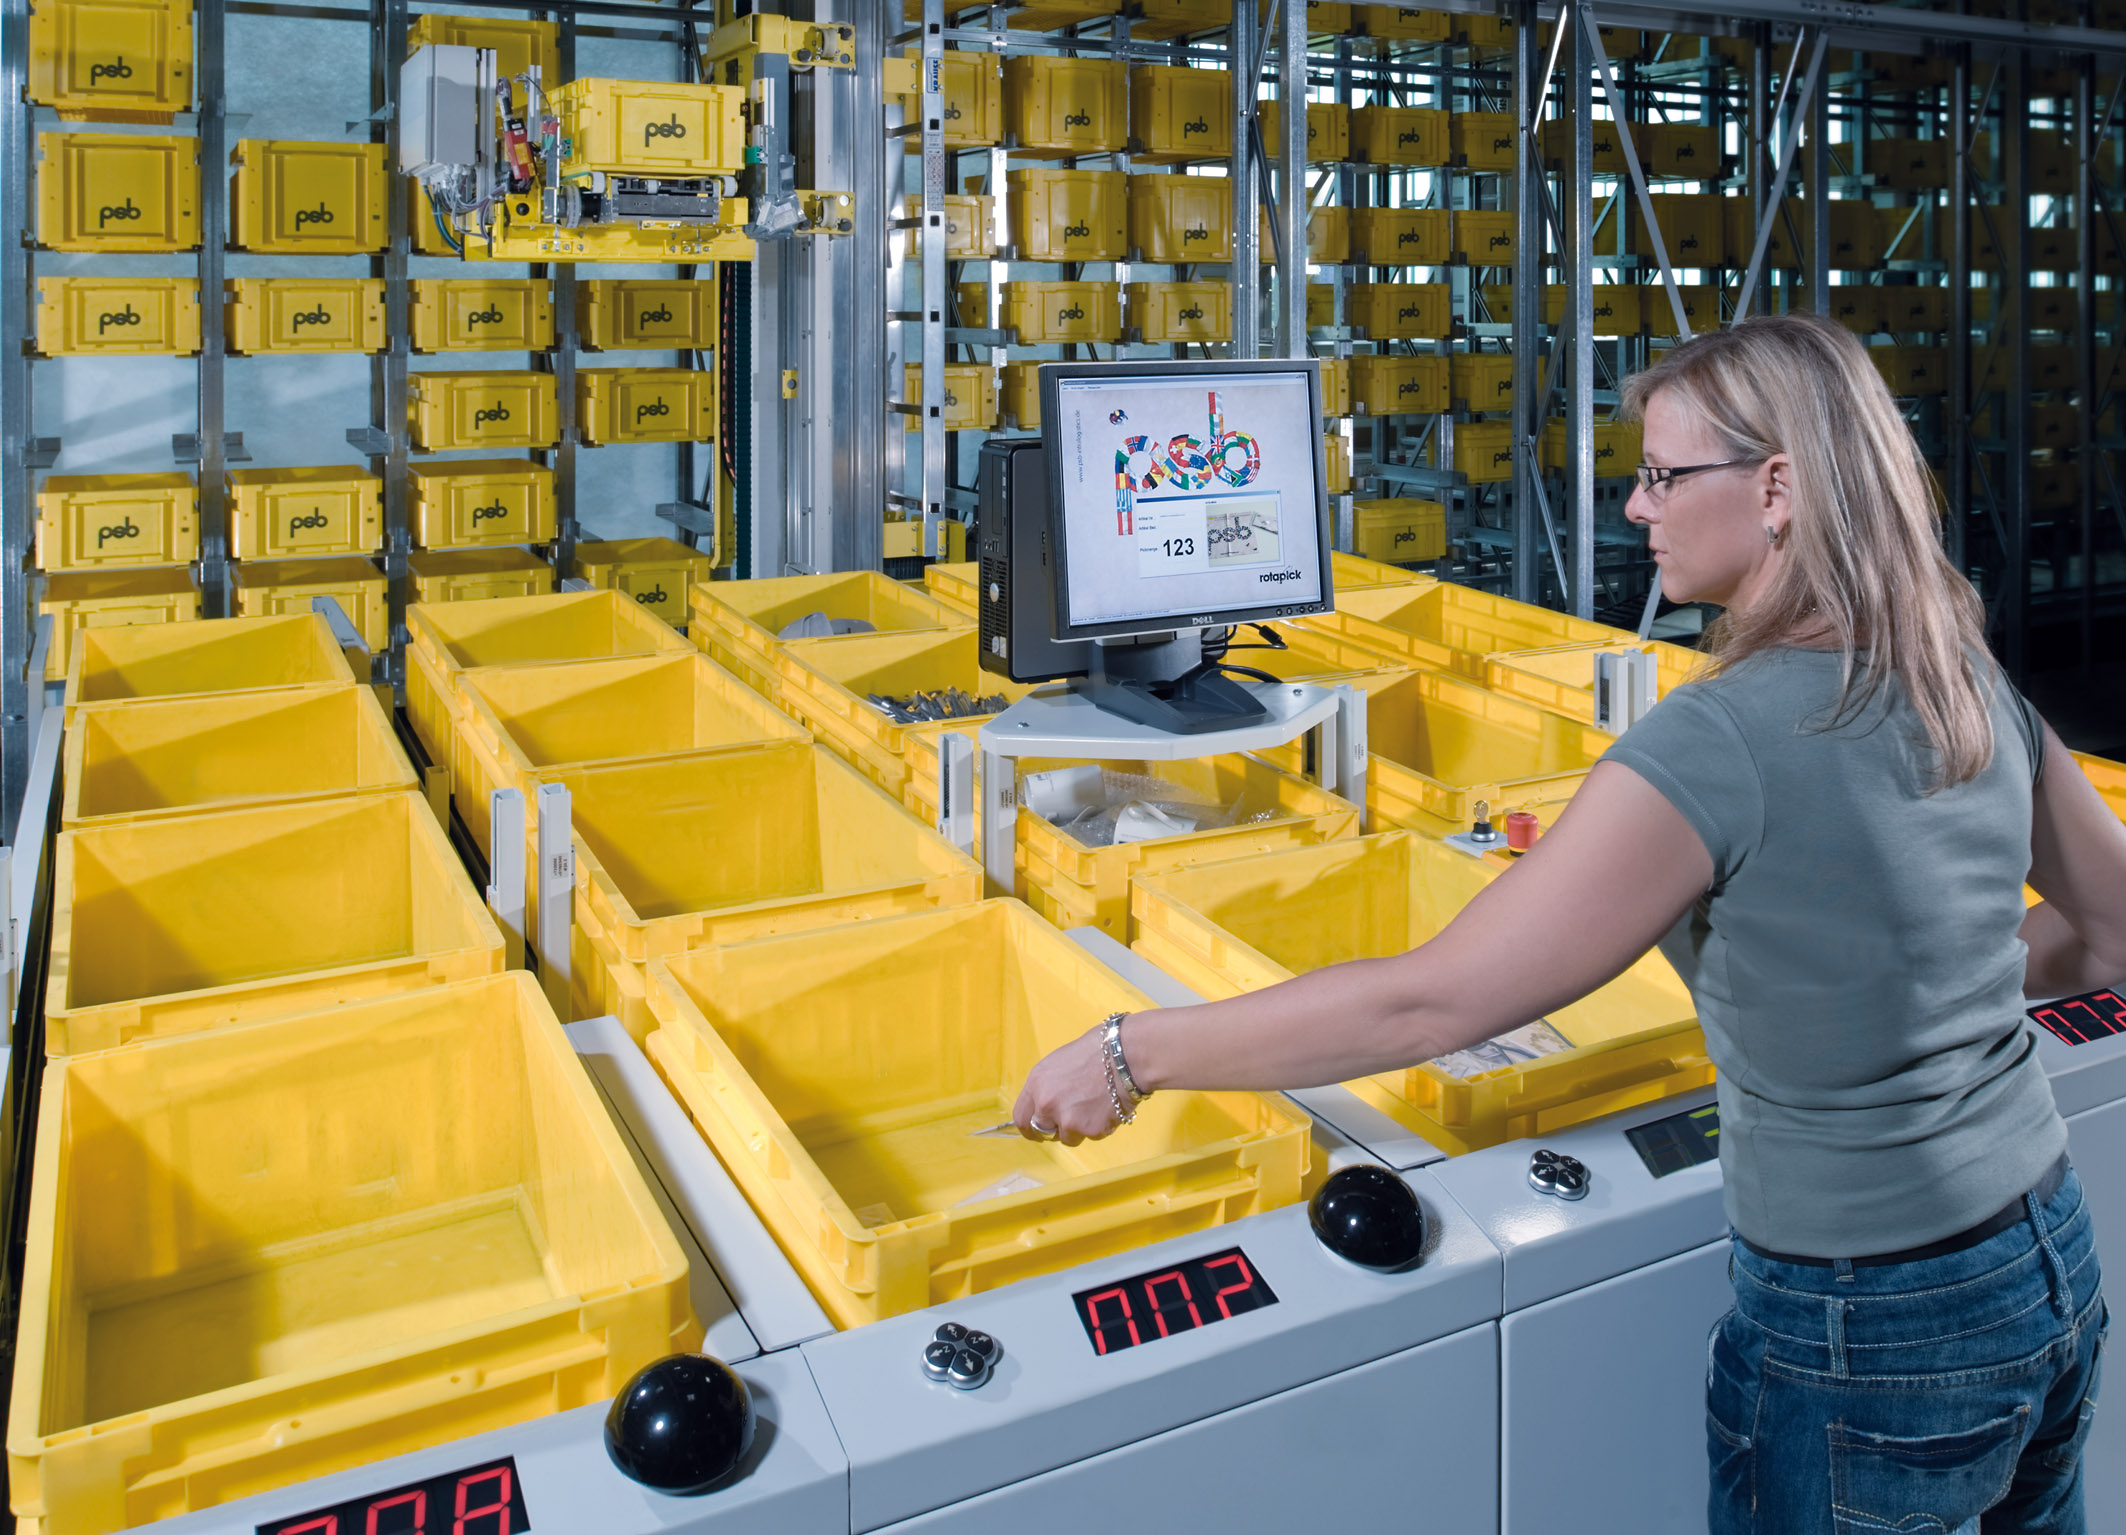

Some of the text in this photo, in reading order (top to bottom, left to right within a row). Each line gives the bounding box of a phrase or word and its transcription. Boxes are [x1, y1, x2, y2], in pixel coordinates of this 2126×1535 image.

[91, 56, 132, 86] psb
[645, 113, 686, 147] psb
[1065, 109, 1091, 131] psb
[1185, 116, 1208, 138] psb
[1399, 127, 1419, 148] psb
[100, 198, 141, 228] psb
[296, 202, 333, 231] psb
[1064, 220, 1090, 243] psb
[1185, 223, 1208, 246] psb
[1399, 228, 1419, 249] psb
[1490, 232, 1510, 251] psb
[100, 304, 140, 334] psb
[293, 304, 331, 333] psb
[469, 303, 503, 332] psb
[641, 303, 672, 330] psb
[1059, 302, 1084, 326] psb
[1180, 302, 1203, 325] psb
[1399, 302, 1419, 324] psb
[1399, 377, 1420, 399] psb
[475, 401, 510, 430] psb
[637, 397, 669, 424] psb
[1595, 443, 1615, 464] psb
[290, 507, 327, 538] psb
[473, 499, 507, 528] psb
[99, 517, 139, 548] psb
[1395, 527, 1415, 548] psb
[1163, 538, 1195, 557] 123
[1259, 569, 1302, 585] rotapick
[1192, 616, 1214, 625] DELL
